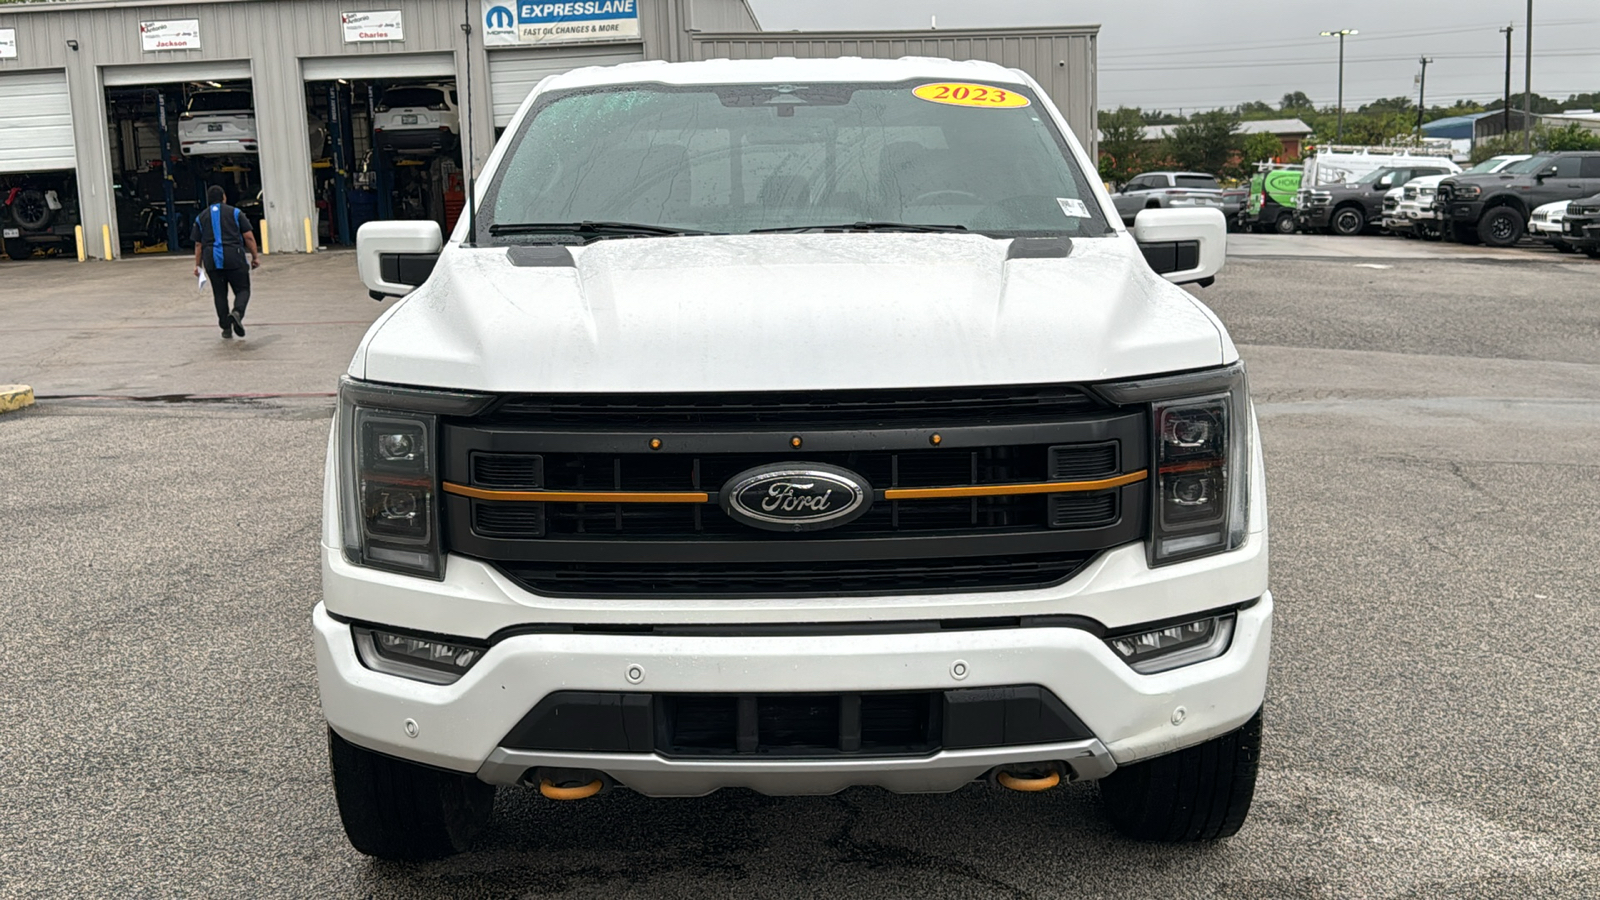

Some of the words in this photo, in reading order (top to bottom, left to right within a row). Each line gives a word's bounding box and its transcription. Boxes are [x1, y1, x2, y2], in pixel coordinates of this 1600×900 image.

[523, 28, 541, 36] FAST
[542, 27, 555, 35] OIL
[556, 25, 590, 34] CHANGES
[591, 25, 597, 33] &
[598, 24, 620, 32] MORE
[156, 40, 187, 48] Jackson
[933, 86, 1007, 103] 2023
[761, 482, 832, 511] Ford
